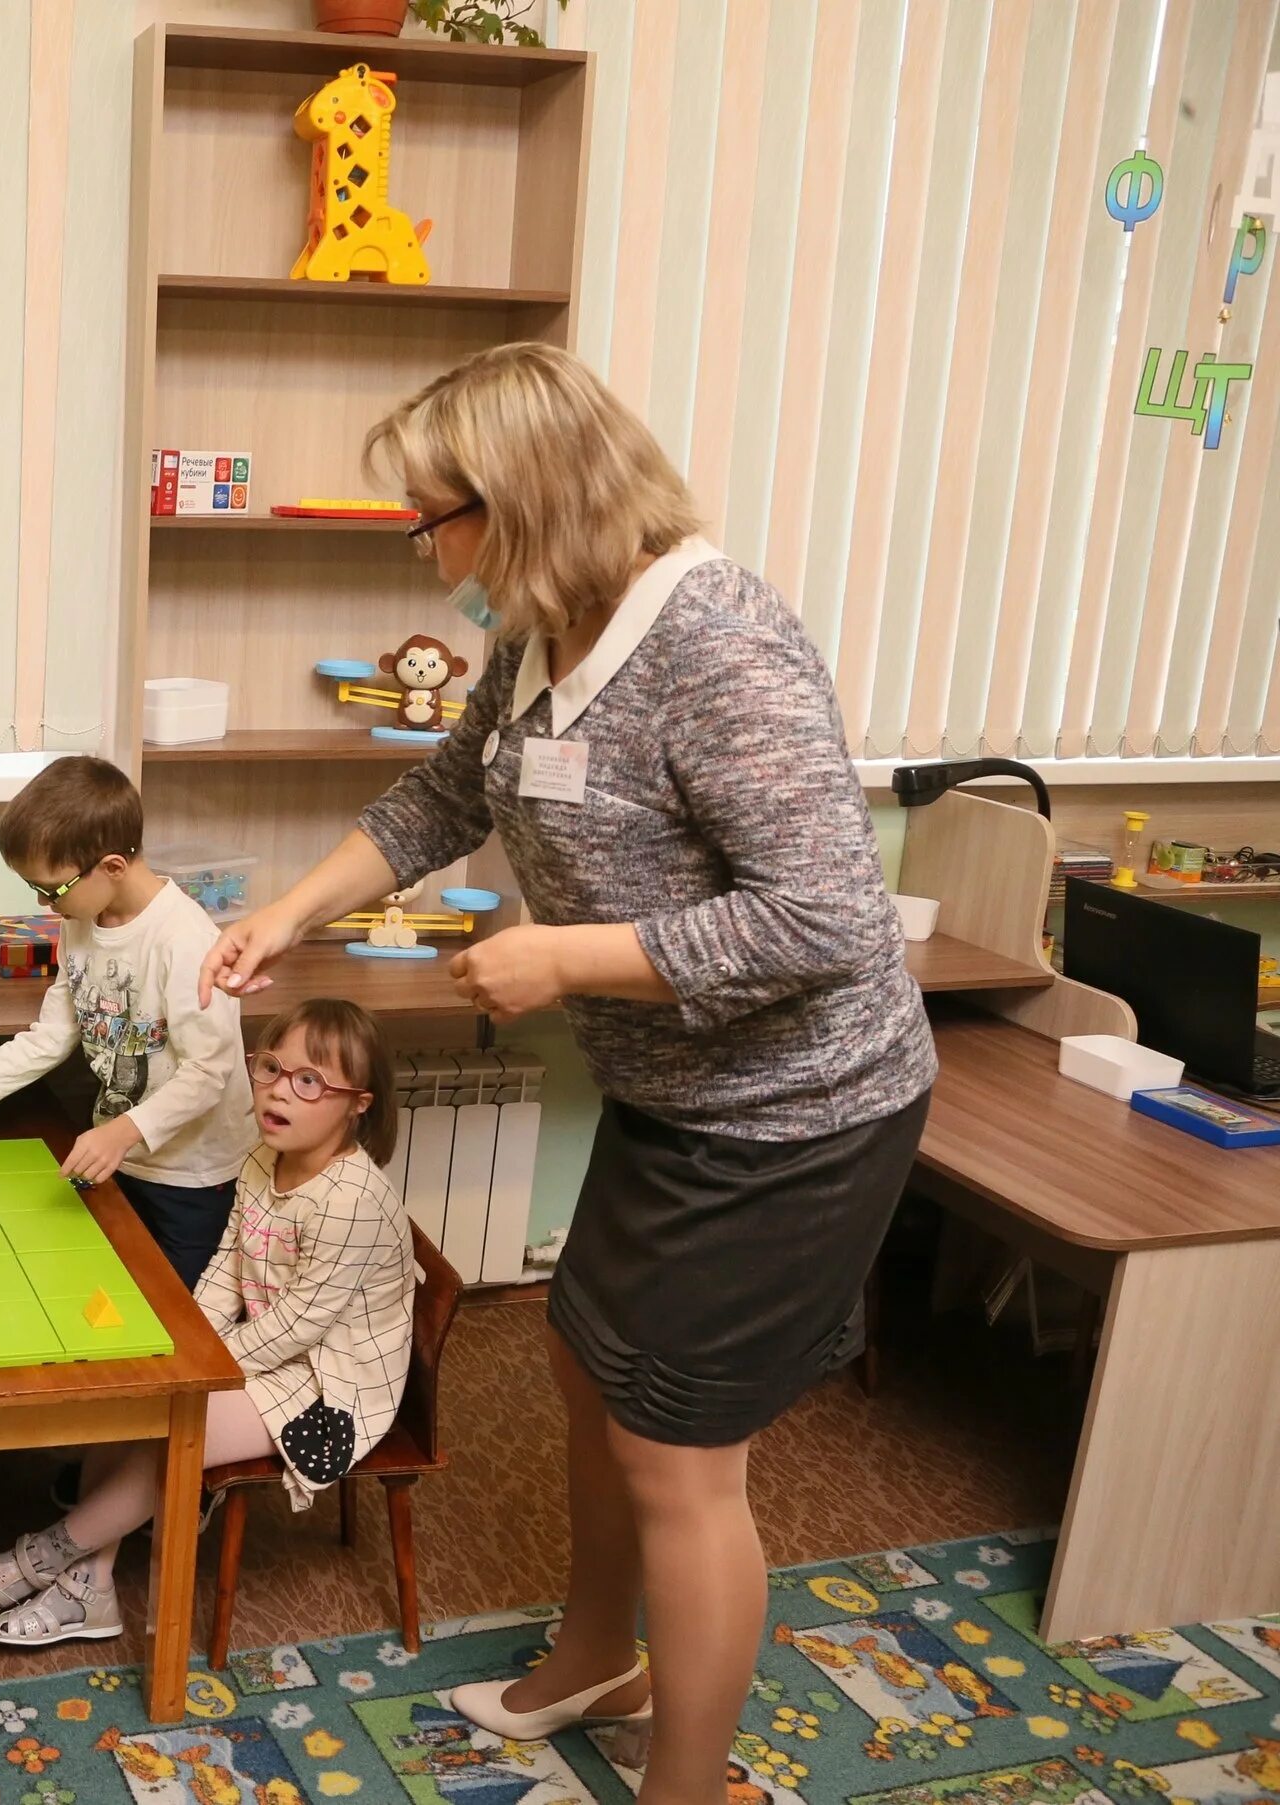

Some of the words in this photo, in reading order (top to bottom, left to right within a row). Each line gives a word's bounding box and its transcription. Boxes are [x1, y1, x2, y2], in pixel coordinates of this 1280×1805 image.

[1105, 150, 1164, 232] Ф
[182, 456, 214, 467] Речевые
[181, 468, 207, 479] кубики
[100, 1000, 119, 1012] MARVEL
